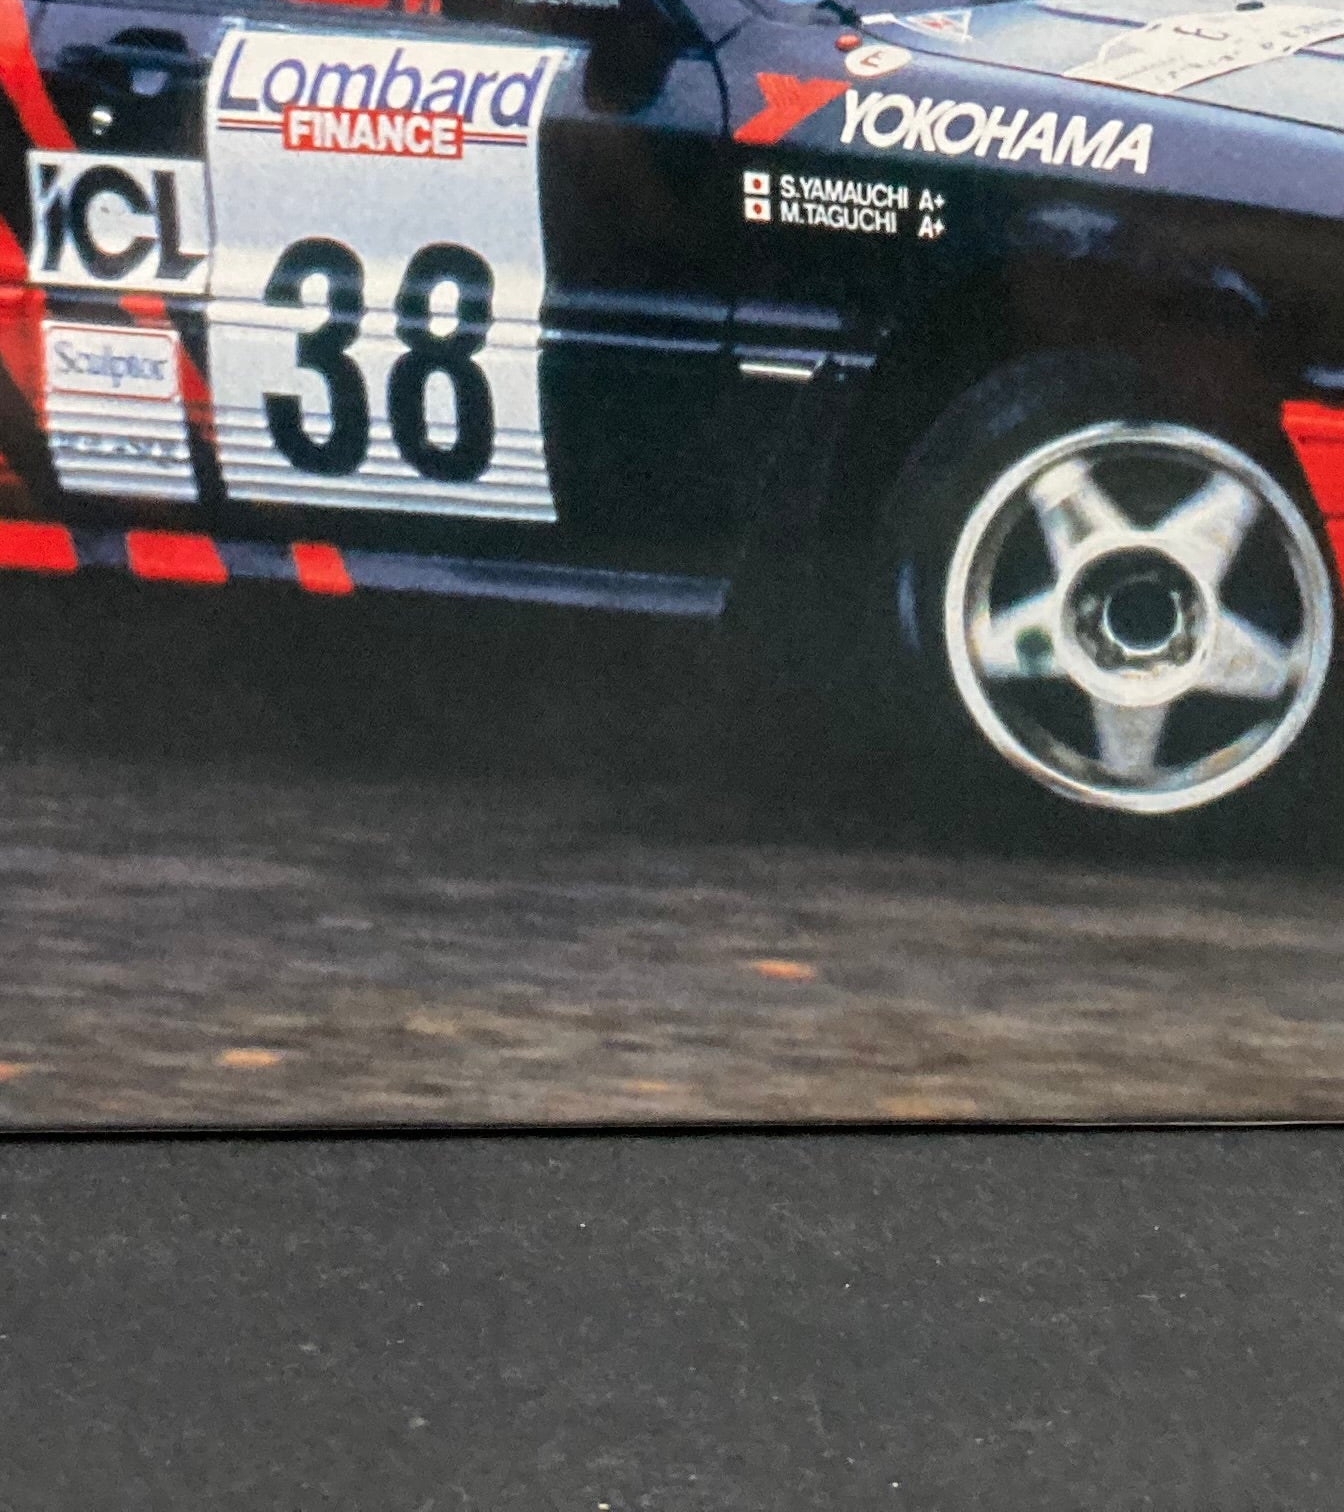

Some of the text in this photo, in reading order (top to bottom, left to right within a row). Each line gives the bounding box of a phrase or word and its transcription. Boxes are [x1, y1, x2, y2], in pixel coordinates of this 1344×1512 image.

[218, 39, 550, 128] Lombard
[287, 110, 459, 156] FINANCE
[839, 88, 1154, 175] YOKOHAMA
[780, 174, 909, 210] S.YAMAUCHI
[780, 200, 897, 234] M.TAGUCHI
[262, 236, 496, 483] 38
